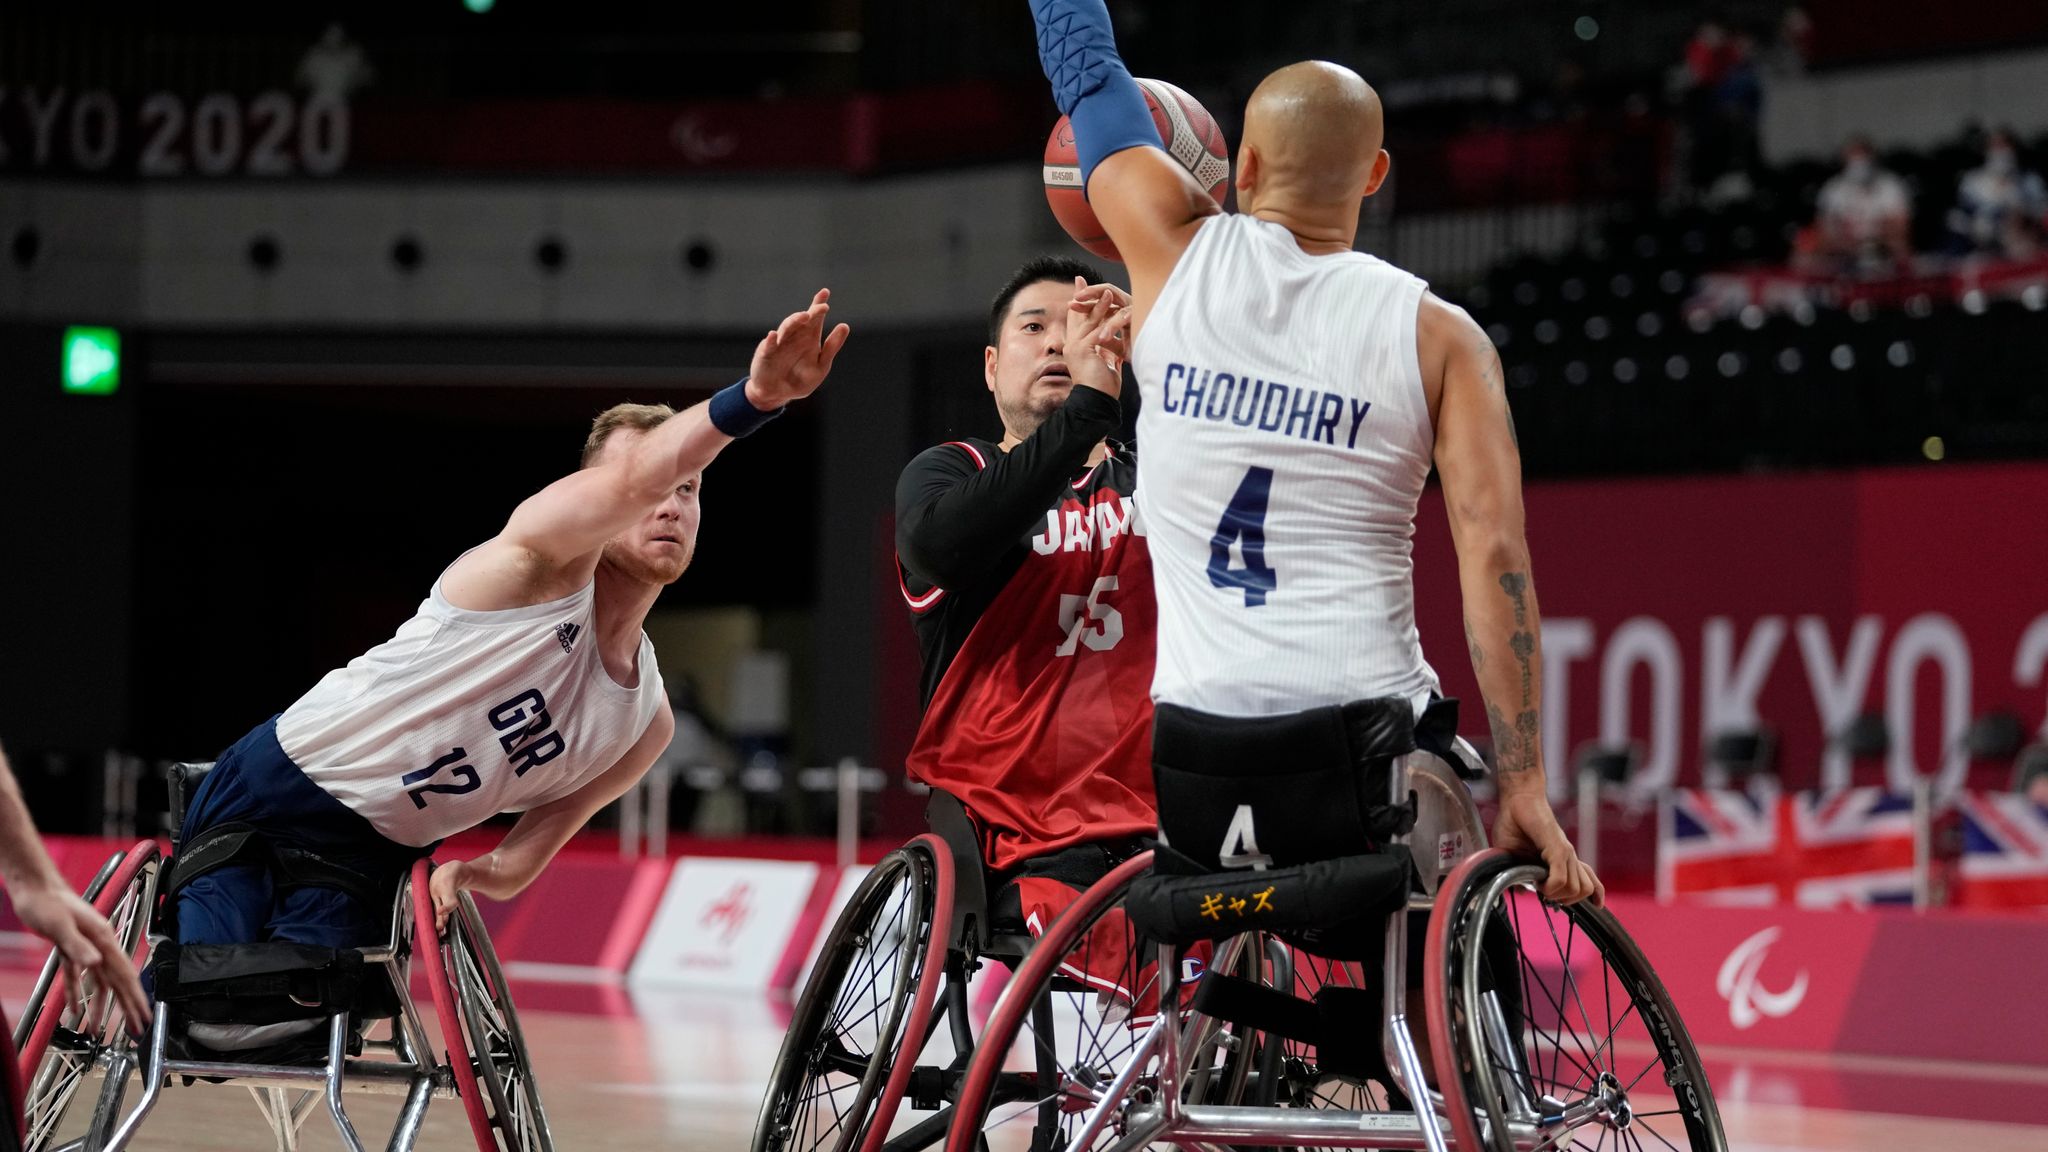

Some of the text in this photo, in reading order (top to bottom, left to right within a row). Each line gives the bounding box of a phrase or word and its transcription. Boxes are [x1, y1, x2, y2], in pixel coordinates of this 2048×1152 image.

[0, 86, 351, 176] YO 2020
[1163, 362, 1371, 449] CHOUDHRY
[1032, 495, 1148, 556] JAPAN
[1206, 465, 1277, 608] 4
[1055, 575, 1125, 657] 55
[488, 688, 566, 778] GBR
[1540, 612, 1973, 806] TOKYO
[402, 747, 482, 810] 12
[1219, 804, 1274, 872] 4
[1200, 886, 1276, 921] ギャズ
[1636, 979, 1705, 1126] SPINEGY
